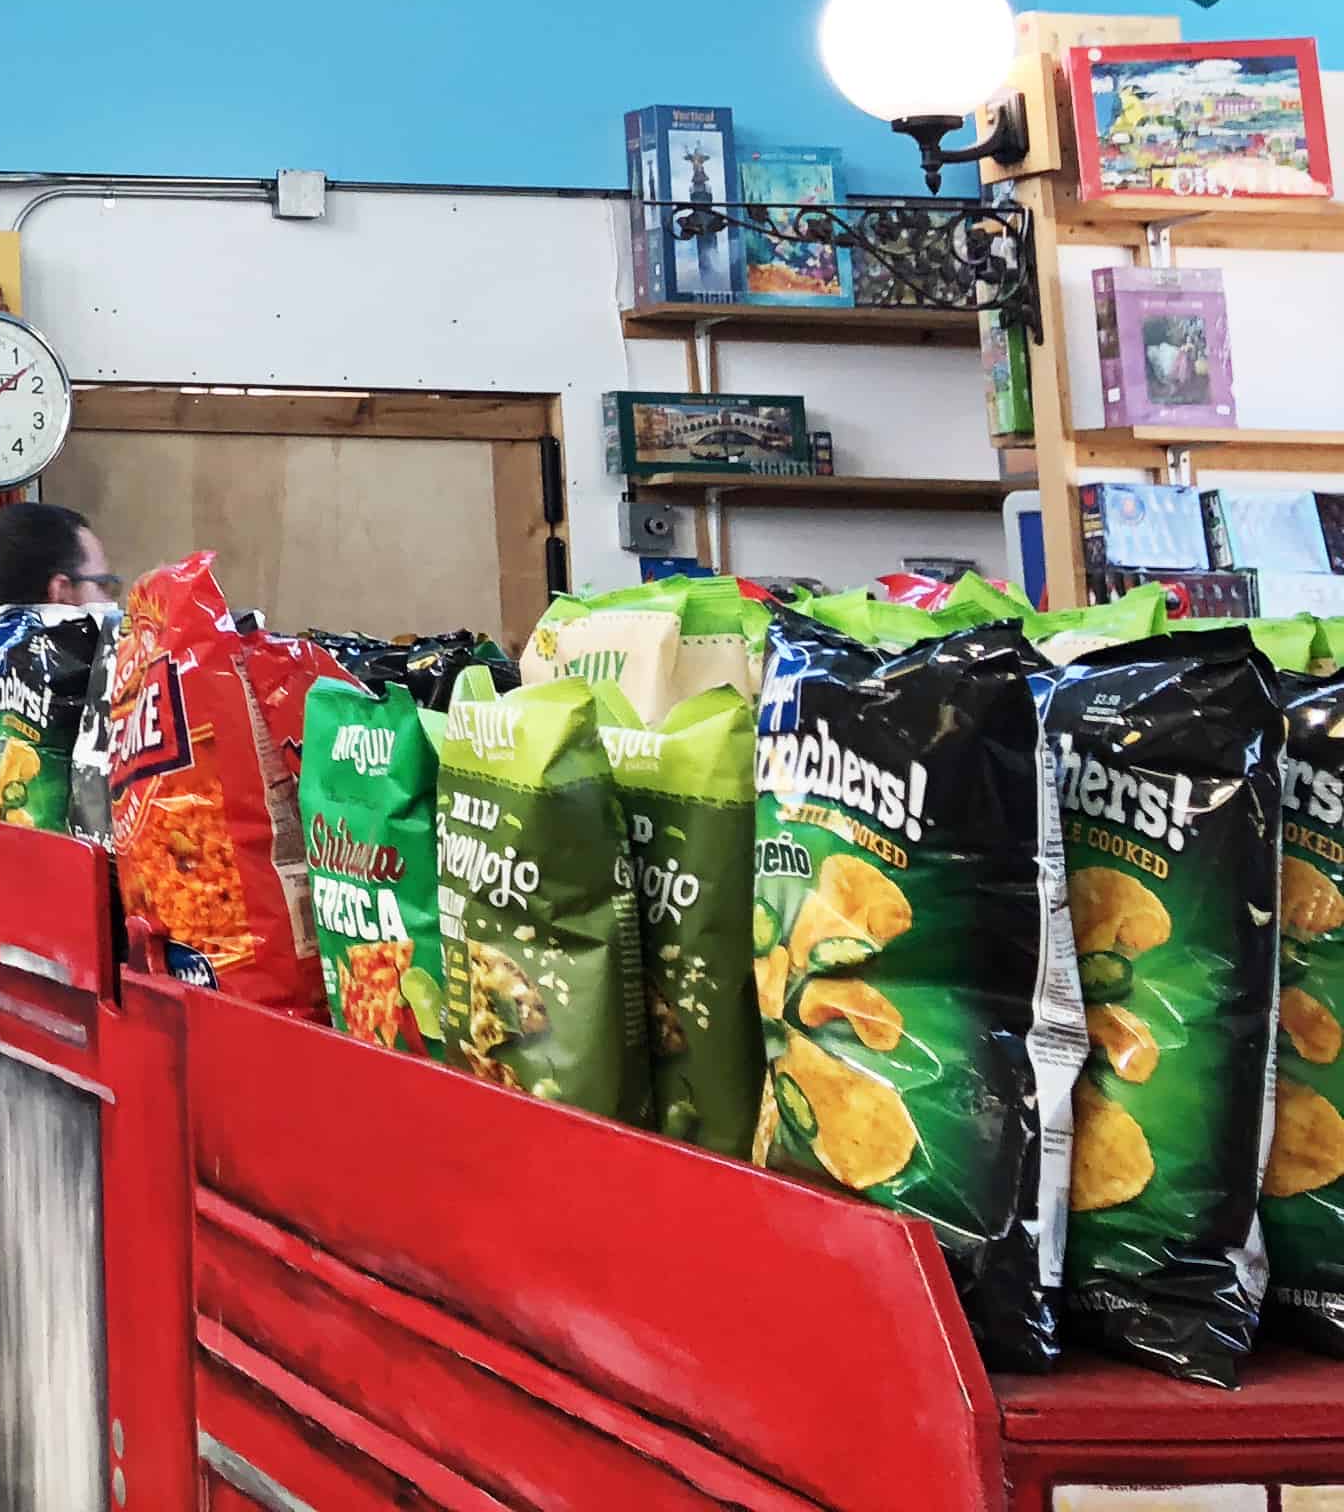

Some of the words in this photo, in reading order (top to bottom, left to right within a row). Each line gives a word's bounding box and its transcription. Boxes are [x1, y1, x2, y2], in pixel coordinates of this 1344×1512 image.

[12, 347, 20, 365] 1
[31, 376, 45, 394] 2
[32, 411, 45, 430] 3
[11, 437, 25, 456] 4
[1088, 826, 1170, 880] COOKED
[1285, 823, 1344, 865] OKED
[313, 875, 410, 942] FRESCA
